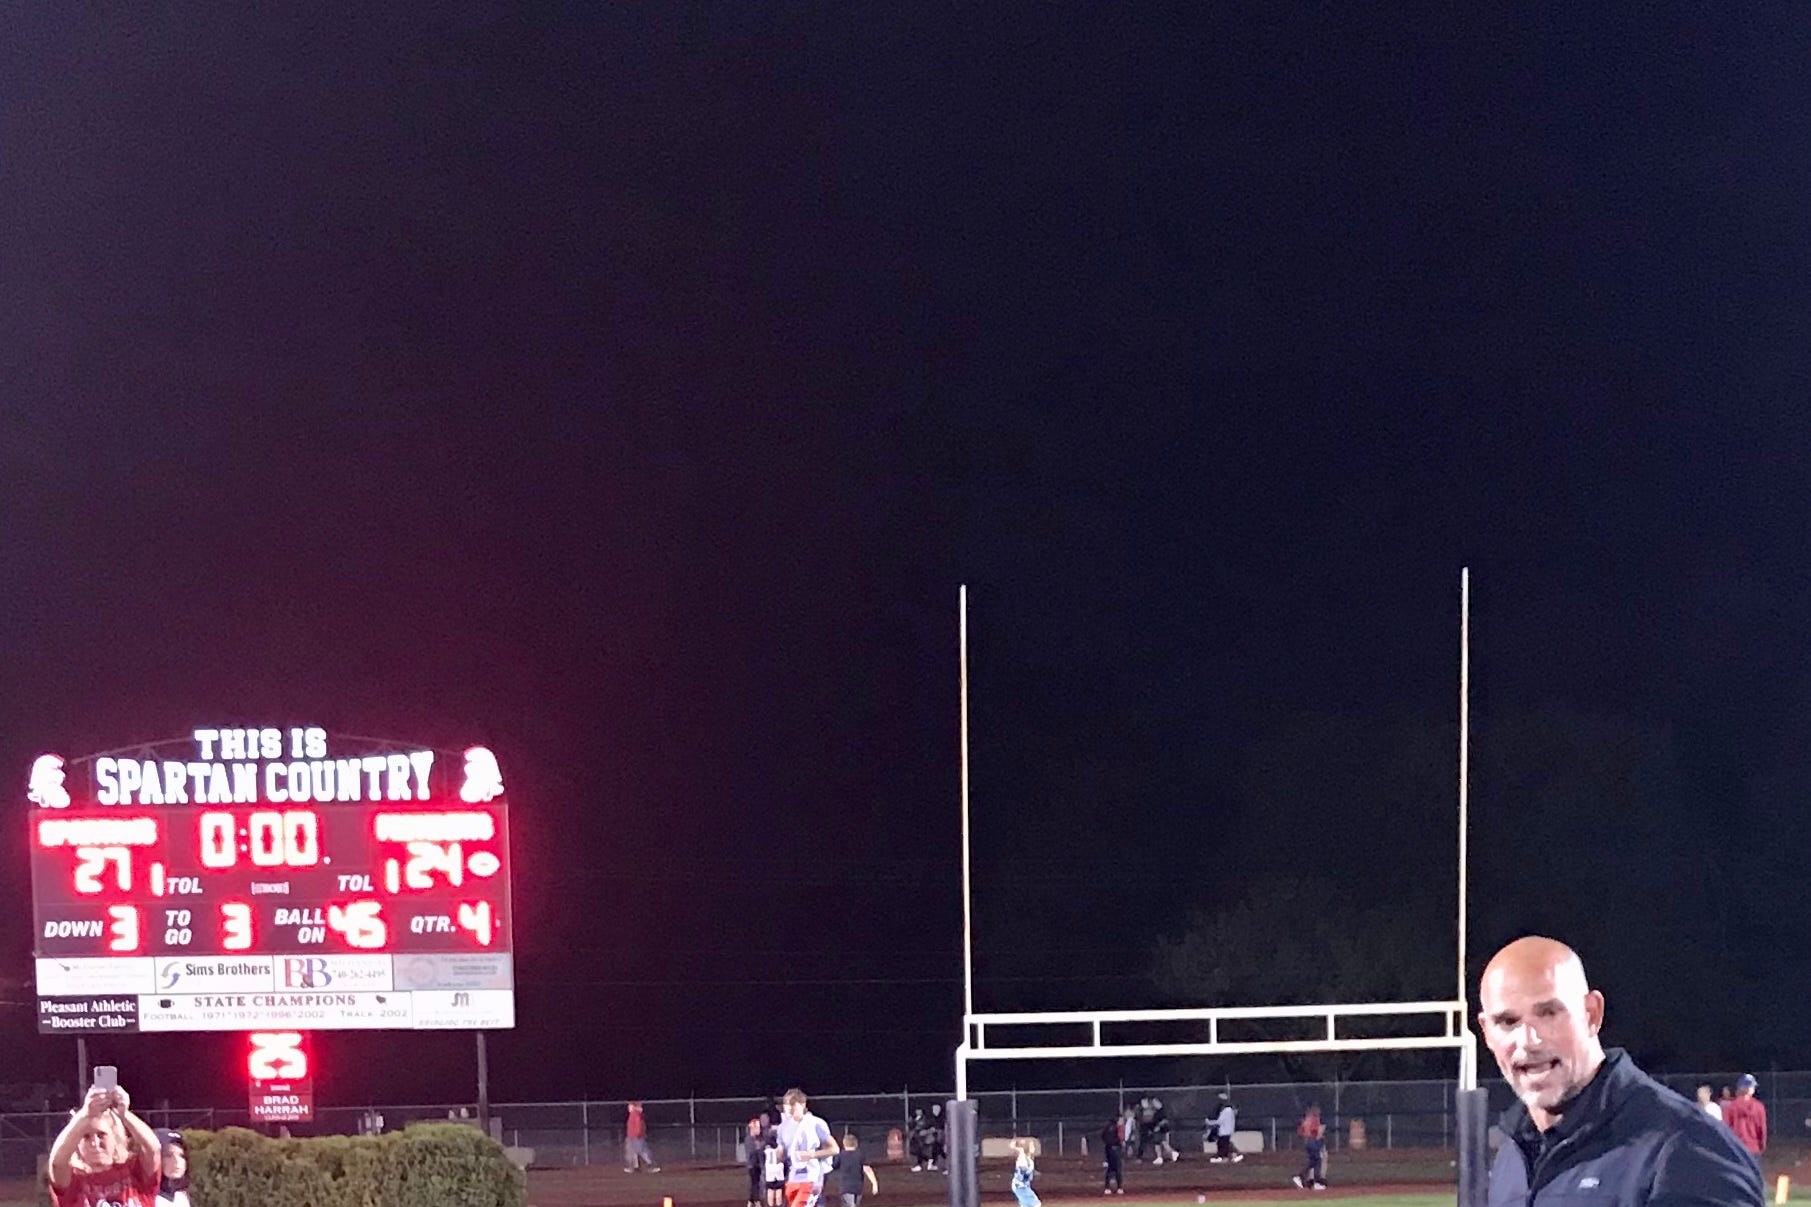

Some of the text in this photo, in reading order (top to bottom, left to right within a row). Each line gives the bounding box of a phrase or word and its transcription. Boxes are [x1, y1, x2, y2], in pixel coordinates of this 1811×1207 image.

[194, 728, 328, 759] THIS IS
[96, 751, 434, 805] SPARTAN COUNTRY
[75, 846, 131, 893] 27
[406, 842, 464, 889] 24
[167, 877, 203, 894] TOL
[338, 874, 374, 892] TOL
[165, 909, 191, 926] TO
[274, 908, 325, 926] BALL
[410, 916, 456, 934] QTR.
[457, 900, 491, 946] 4
[44, 920, 104, 938] DOWN
[108, 905, 138, 951] 3
[222, 903, 252, 950] 3
[298, 927, 325, 944] ON
[165, 928, 192, 945] GO
[185, 963, 271, 976] Sims Brothers
[40, 999, 136, 1013] Pleasant Athletic
[194, 994, 356, 1008] STATE CHAMPIONS
[263, 1095, 299, 1105] BRAD
[254, 1104, 309, 1115] HARRAH
